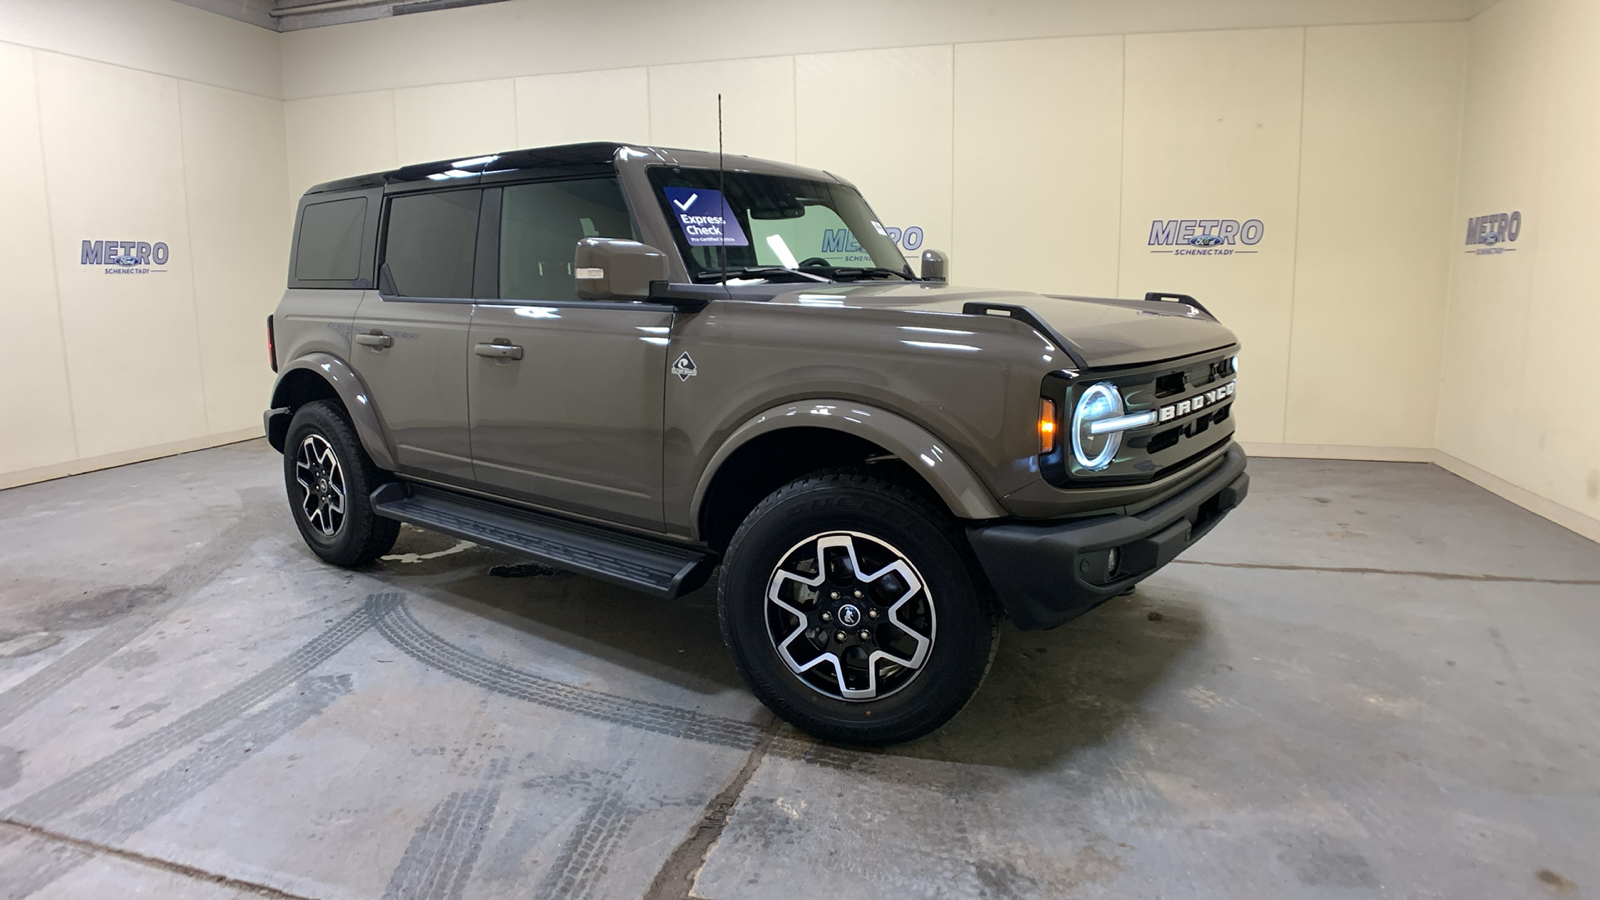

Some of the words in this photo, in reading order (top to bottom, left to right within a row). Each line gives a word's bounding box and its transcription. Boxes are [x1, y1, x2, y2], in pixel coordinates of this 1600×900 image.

[680, 214, 726, 225] Express
[686, 225, 722, 235] Check
[1148, 219, 1264, 245] METRO
[1465, 211, 1522, 245] METRO
[81, 240, 169, 265] METRO
[821, 226, 924, 253] MERO
[1159, 382, 1236, 422] BRONCO
